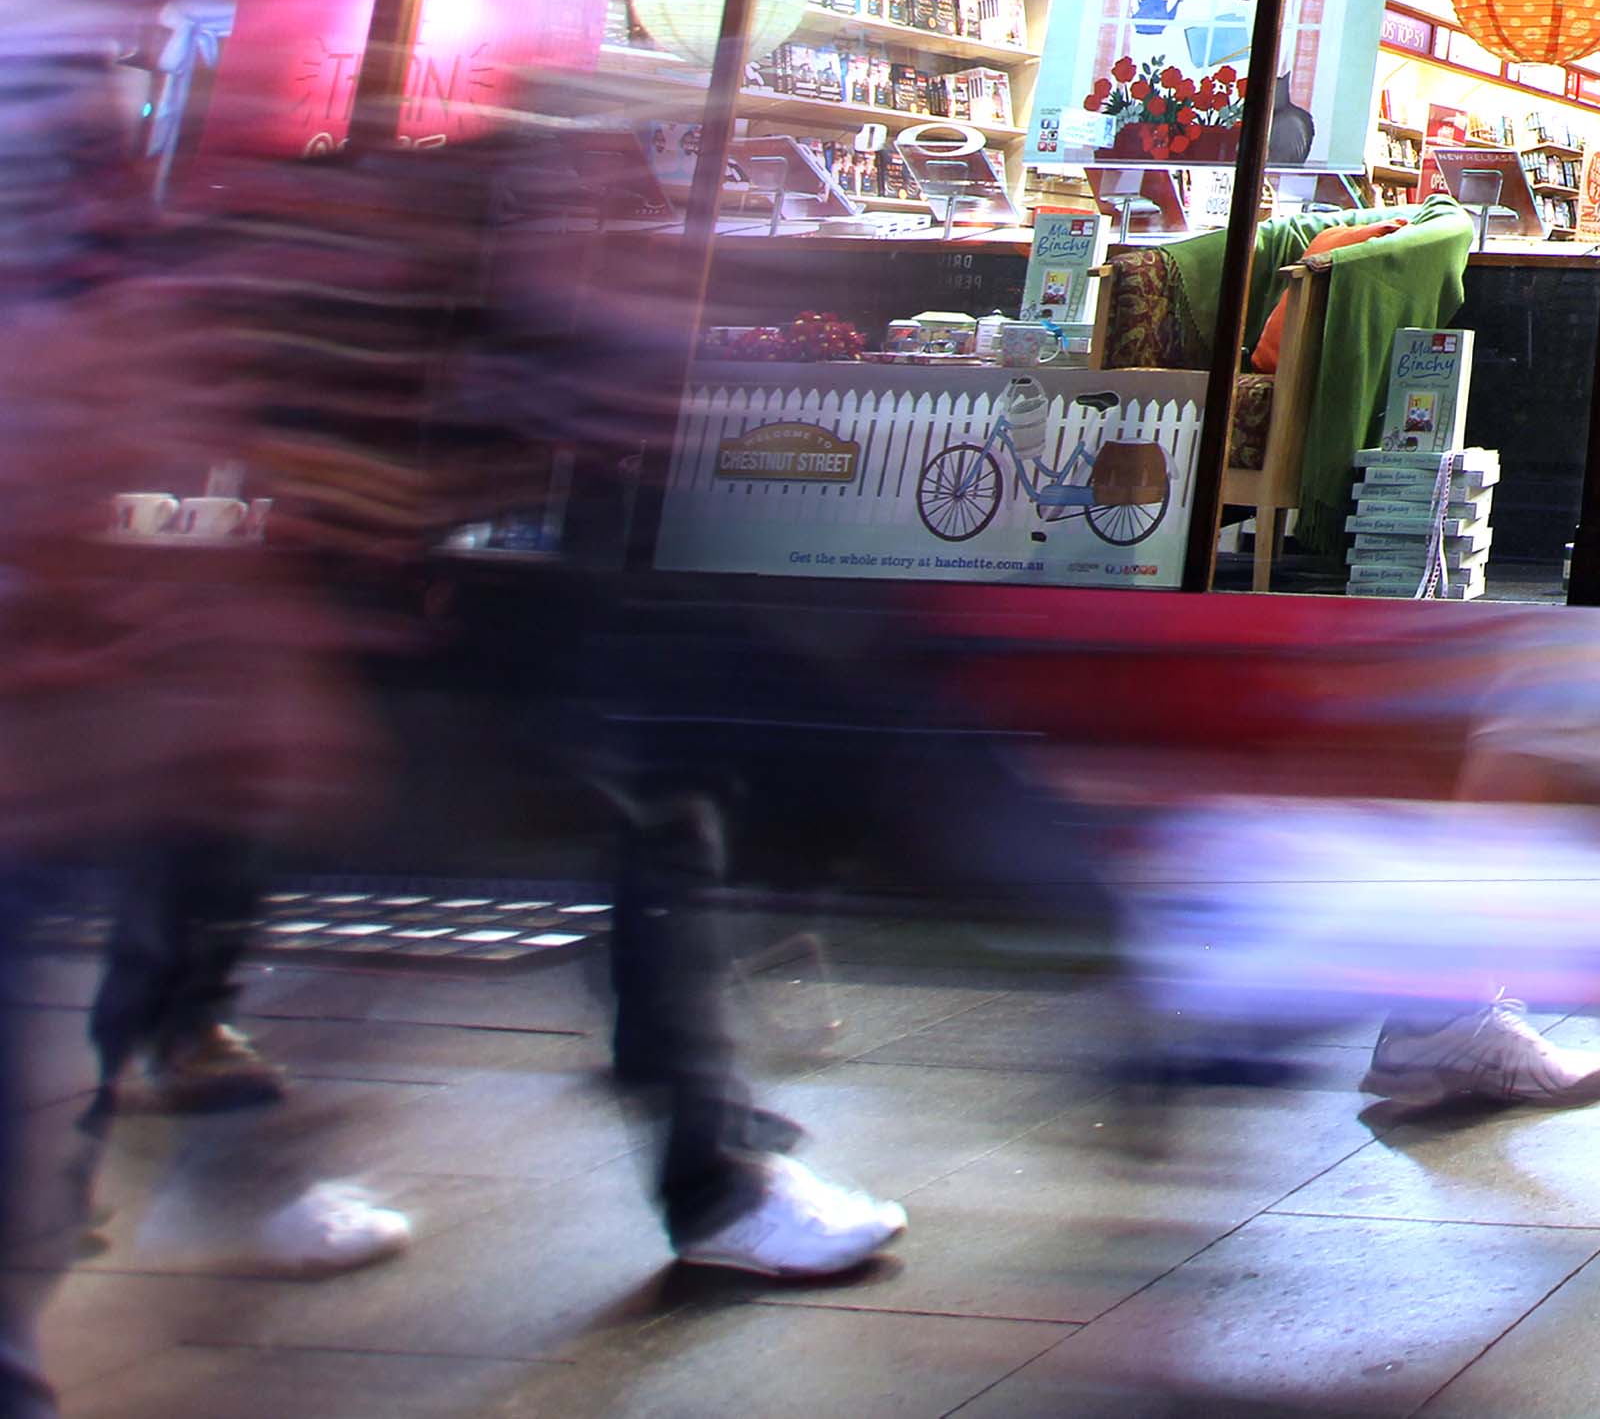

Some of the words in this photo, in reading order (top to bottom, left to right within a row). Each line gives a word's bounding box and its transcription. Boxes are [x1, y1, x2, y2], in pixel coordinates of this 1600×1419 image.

[1037, 236, 1090, 258] Binchy
[1397, 354, 1456, 380] Binchy
[744, 430, 810, 447] WELCOME
[817, 437, 832, 449] TO
[721, 451, 794, 471] CHESTNUT
[798, 453, 853, 472] STREET
[790, 551, 812, 563] Get
[815, 552, 836, 565] the
[839, 553, 879, 567] whole
[881, 555, 914, 569] story
[918, 557, 930, 567] at
[935, 556, 1044, 571] hachette.com.au
